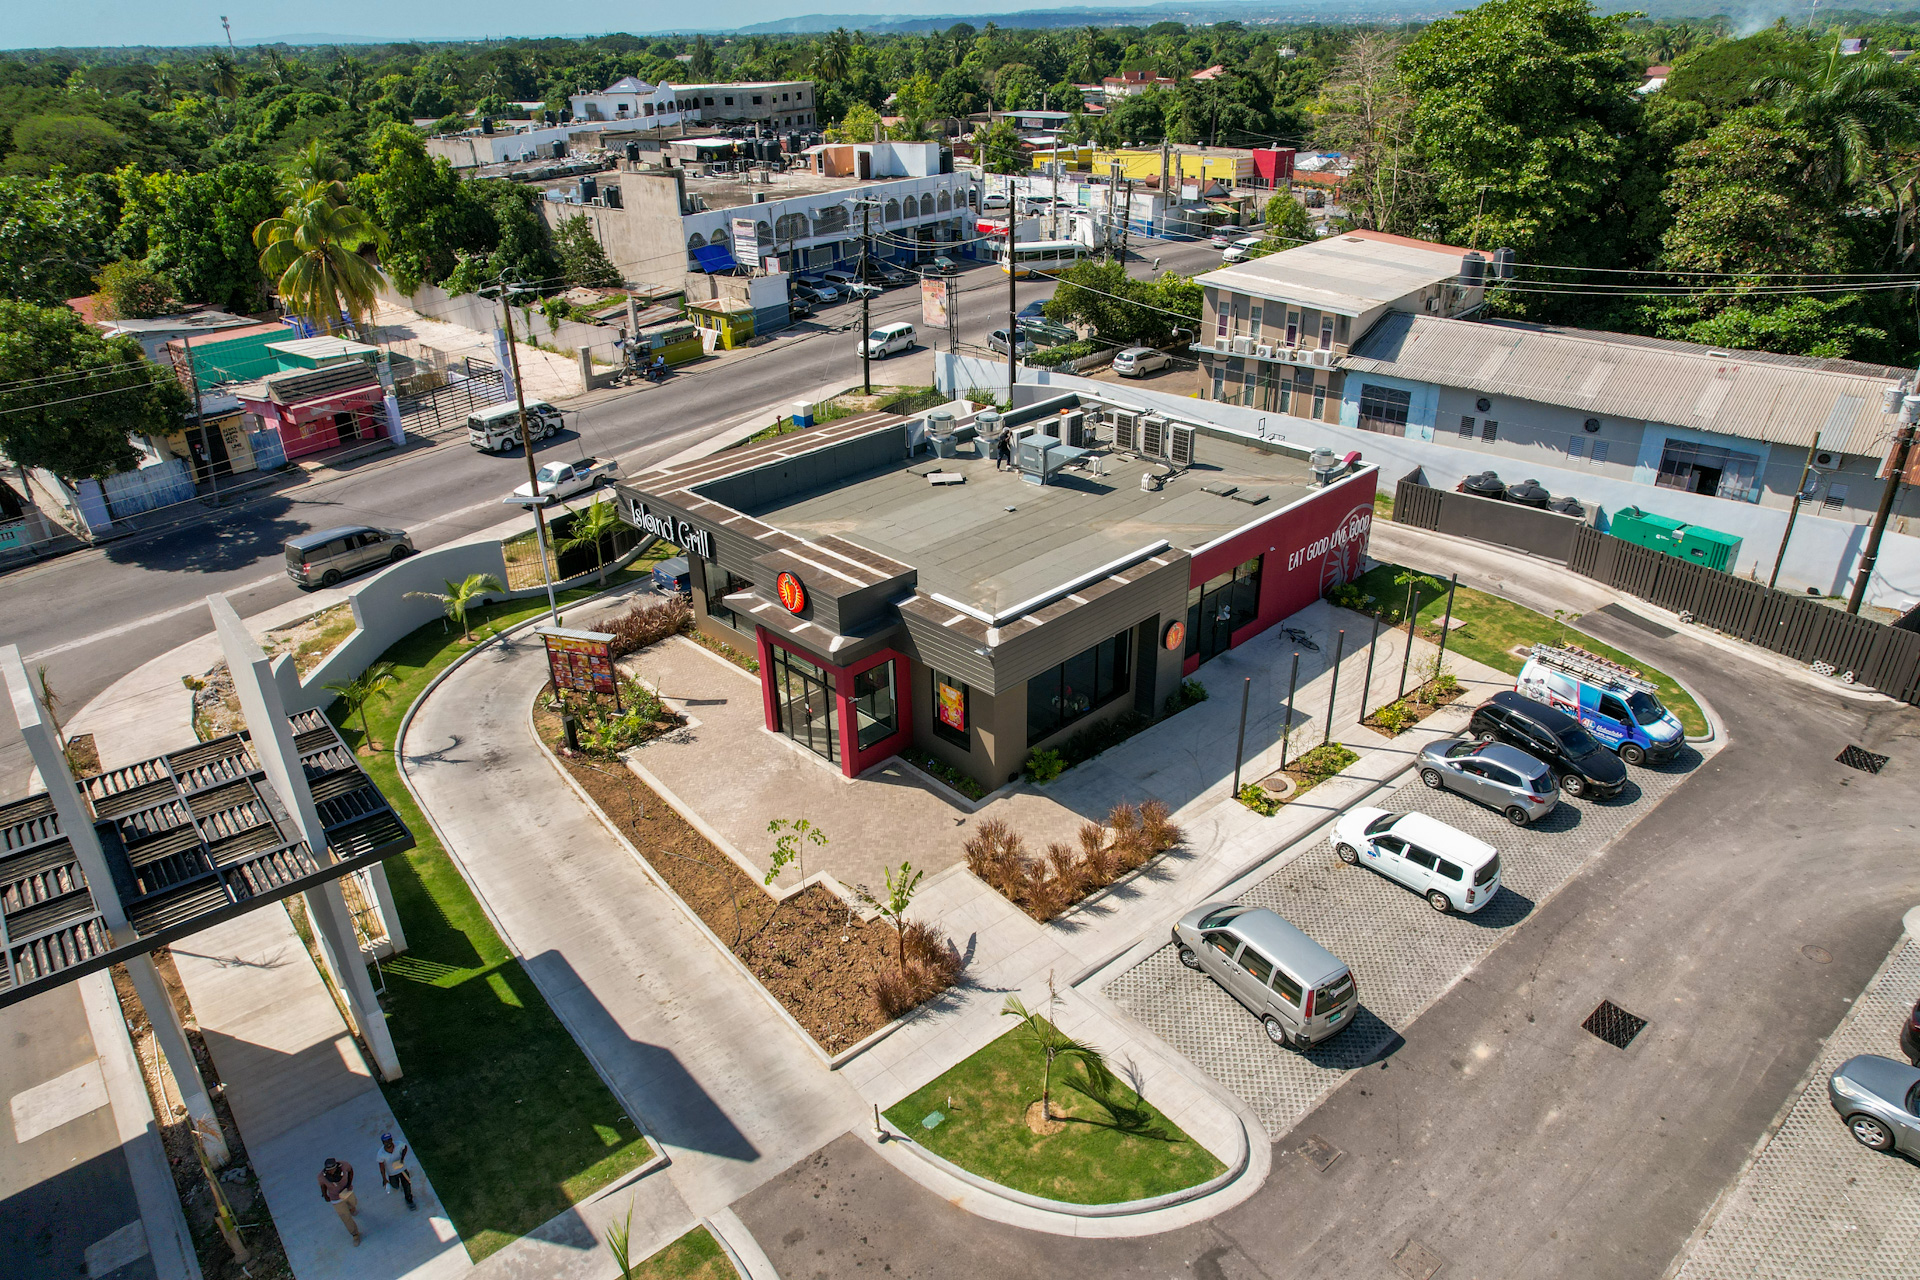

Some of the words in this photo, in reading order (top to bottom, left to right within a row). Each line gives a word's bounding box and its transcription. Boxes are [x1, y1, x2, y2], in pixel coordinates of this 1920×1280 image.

[630, 499, 675, 542] Island
[678, 521, 710, 559] Grill
[1288, 547, 1306, 572] EAT
[1306, 536, 1329, 561] GOOD
[1330, 525, 1348, 550] LIVE
[1349, 514, 1370, 539] GOOD
